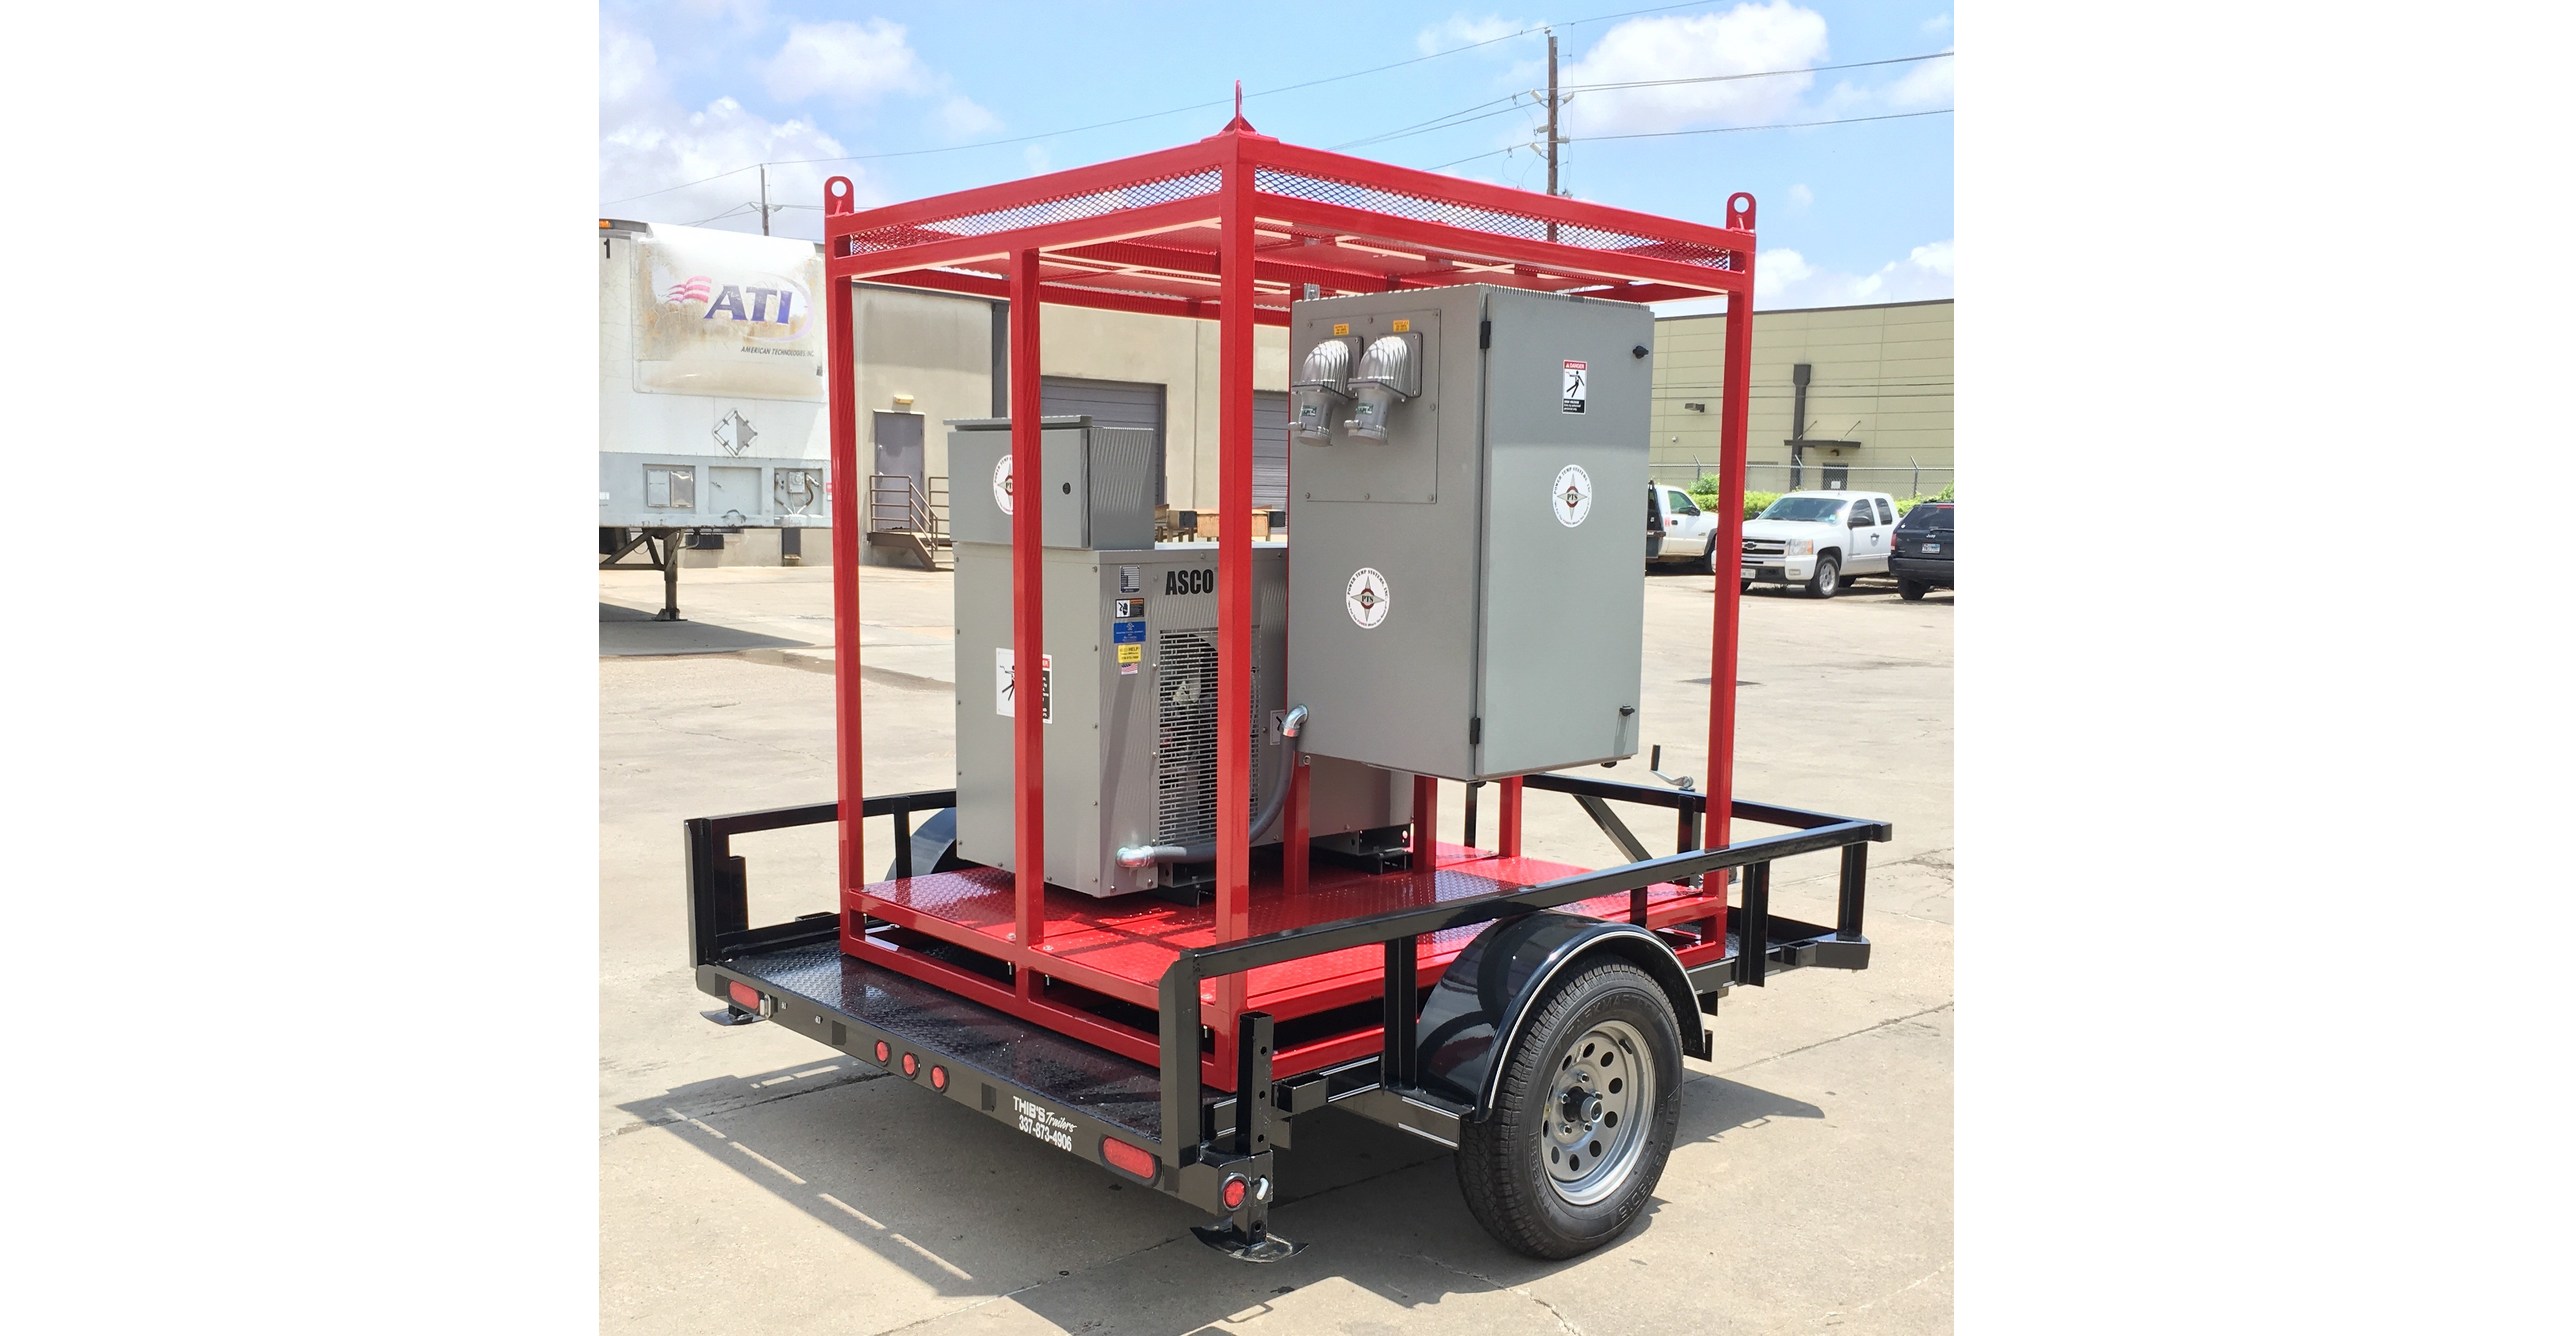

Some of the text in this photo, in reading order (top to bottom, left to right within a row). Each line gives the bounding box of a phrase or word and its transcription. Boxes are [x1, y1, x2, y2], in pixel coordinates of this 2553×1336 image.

[603, 238, 610, 259] 1
[703, 285, 793, 324] ATI
[741, 346, 771, 355] AMERICAN
[1165, 569, 1214, 595] ASCO
[1012, 1095, 1078, 1133] THIB'S Trailers
[1018, 1114, 1072, 1152] 337-873-4906
